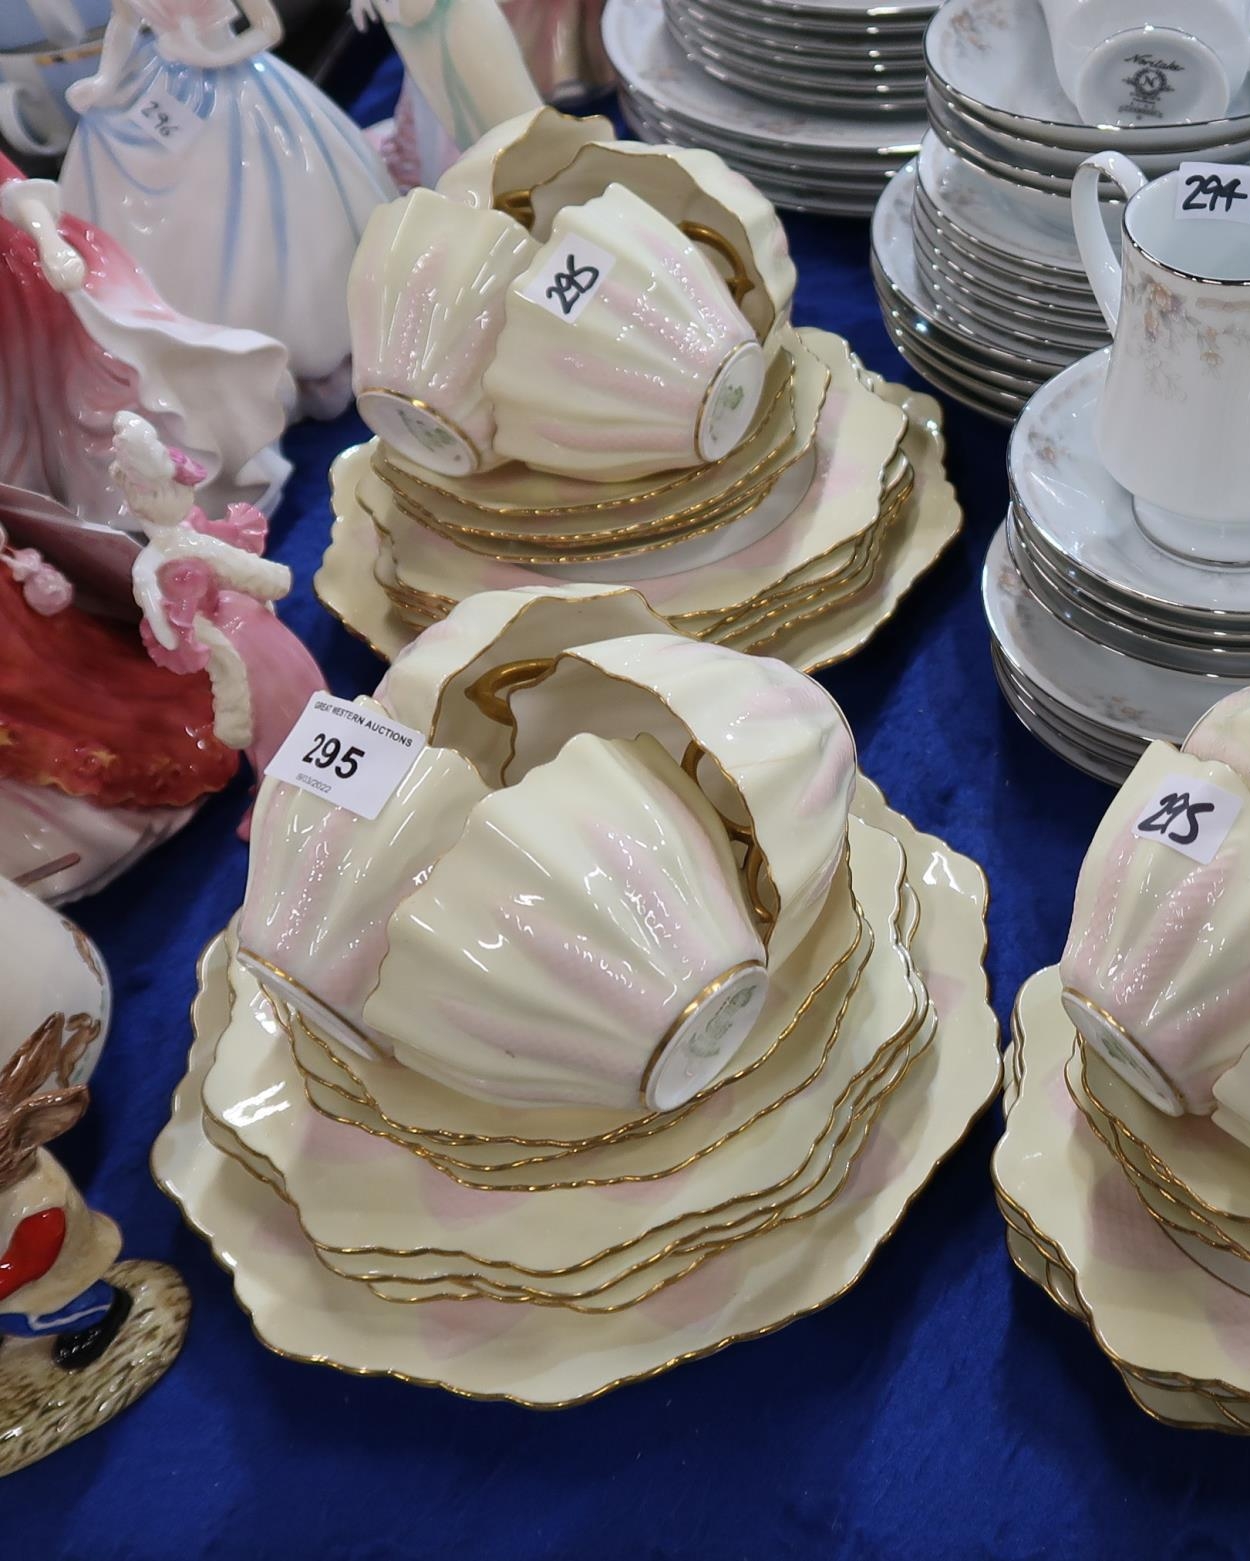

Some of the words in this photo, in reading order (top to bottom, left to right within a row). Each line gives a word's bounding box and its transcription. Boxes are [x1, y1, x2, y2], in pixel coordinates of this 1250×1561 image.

[141, 101, 179, 136] 296
[1182, 174, 1248, 212] 294
[545, 254, 599, 315] 295
[314, 701, 333, 712] GREAT
[332, 706, 365, 726] WESTERN
[365, 720, 413, 747] AUCTIONS
[302, 733, 365, 779] 295
[1138, 793, 1215, 845] 295
